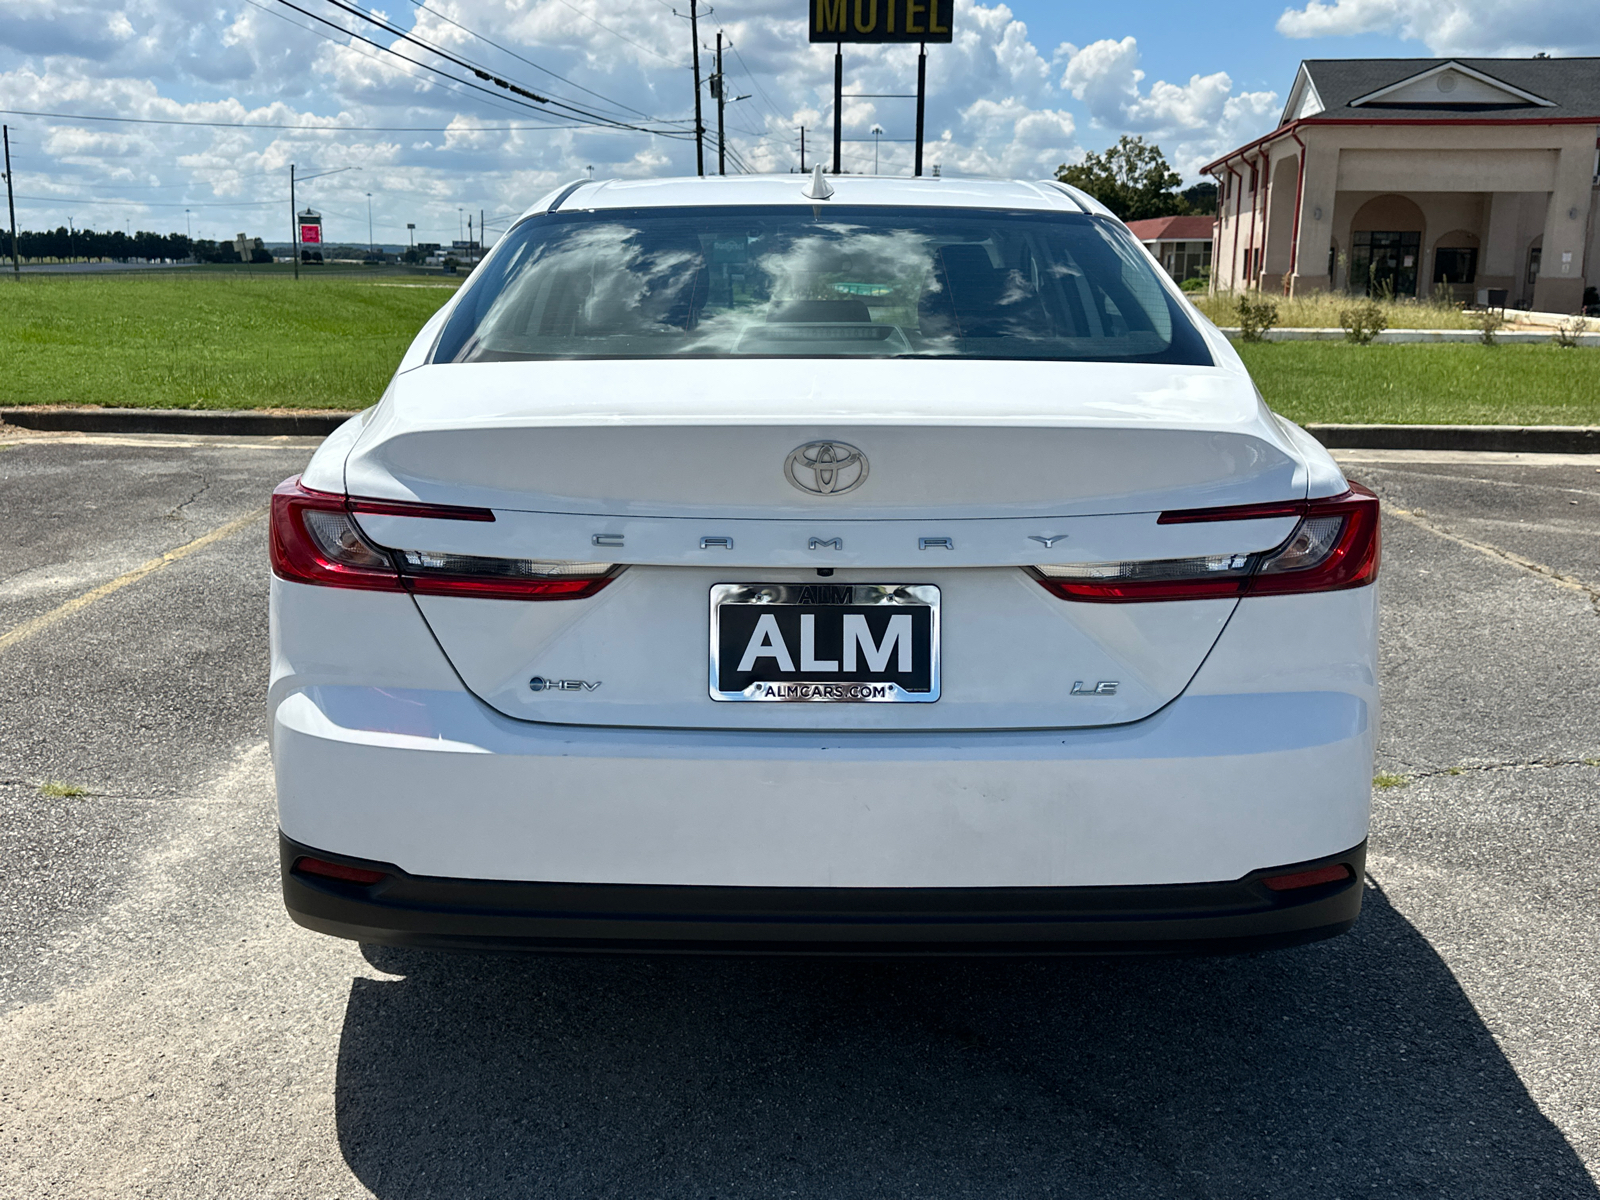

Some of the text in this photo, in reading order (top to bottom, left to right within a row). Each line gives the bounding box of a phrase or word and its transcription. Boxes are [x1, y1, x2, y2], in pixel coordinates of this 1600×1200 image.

[591, 533, 1070, 551] CAMRY
[796, 585, 854, 605] ALM
[736, 613, 913, 673] ALM
[545, 679, 603, 692] HEV
[764, 685, 886, 698] ALMCARS.COM
[1069, 680, 1120, 696] LE
